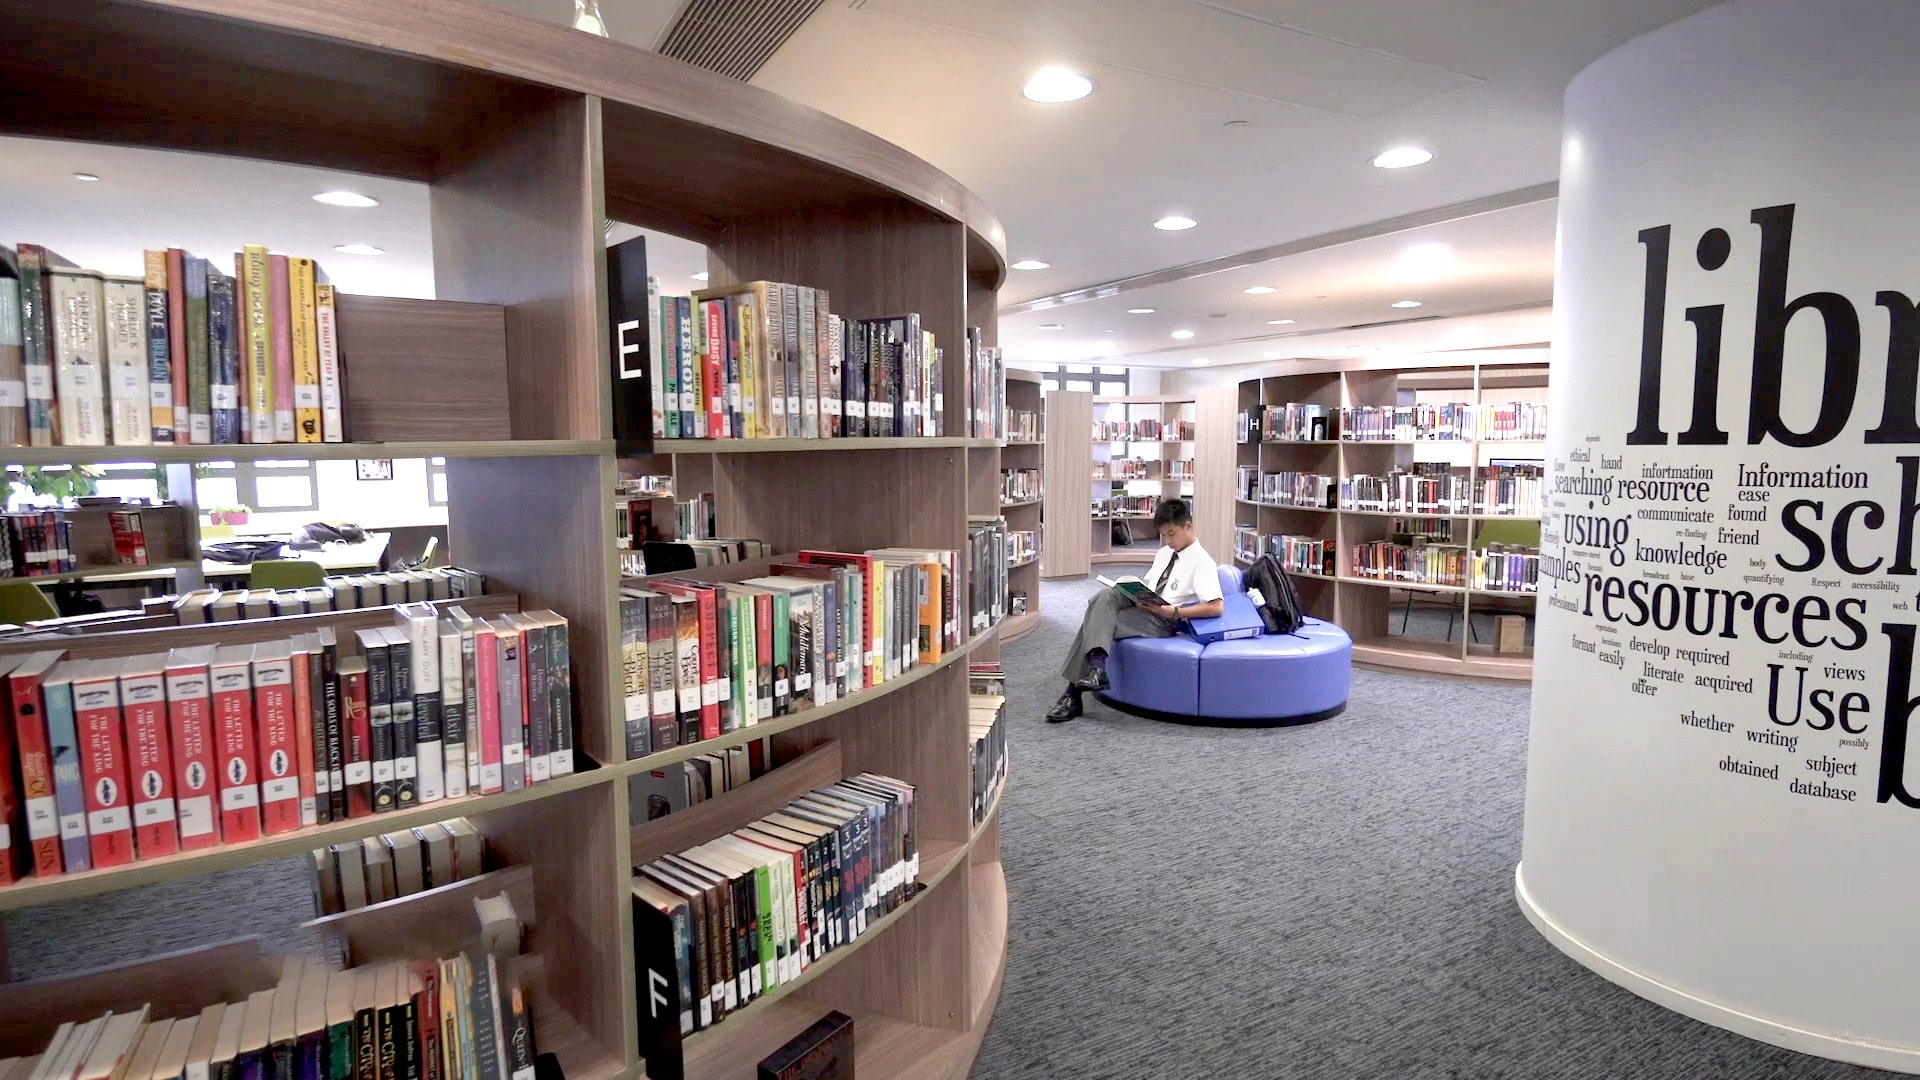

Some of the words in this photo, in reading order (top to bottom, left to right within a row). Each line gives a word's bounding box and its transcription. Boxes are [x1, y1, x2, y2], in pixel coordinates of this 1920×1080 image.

[116, 303, 128, 343] HOLMES
[127, 298, 139, 349] SHERLOCK
[618, 320, 642, 379] E
[681, 317, 692, 393] HEROI
[711, 338, 720, 365] DAISY
[1250, 418, 1259, 431] H
[1570, 448, 1591, 462] ethical
[1601, 454, 1623, 469] hand
[1642, 463, 1714, 480] infortmation
[1738, 462, 1868, 488] Information
[1555, 467, 1614, 505] searching
[1617, 480, 1710, 502] resource
[1738, 490, 1770, 502] ease
[1637, 507, 1715, 523] communicate
[1728, 504, 1767, 521] found
[1564, 501, 1632, 567] using
[1717, 527, 1759, 545] friend
[1635, 539, 1728, 575] knowledge
[1750, 558, 1766, 569] body
[1743, 574, 1784, 586] quantifying
[1811, 578, 1841, 589] Respect
[1851, 581, 1901, 592] accessibility
[1582, 572, 1868, 650] resources
[1892, 601, 1908, 610] web
[421, 626, 429, 657] HILARY
[705, 603, 716, 667] SUSPECT
[1572, 633, 1596, 653] format
[799, 618, 810, 675] Middlemarc
[1629, 637, 1670, 661] develop
[1675, 645, 1730, 667] required
[1778, 650, 1813, 664] including
[664, 651, 674, 689] Burie
[1599, 650, 1625, 670] easily
[423, 661, 431, 683] DUFF
[623, 661, 635, 697] Blad
[1643, 662, 1684, 684] literate
[1694, 672, 1753, 694] acquired
[1823, 663, 1865, 681] views
[325, 682, 333, 694] THE
[1631, 679, 1658, 697] offer
[1767, 663, 1870, 734] Use
[136, 709, 145, 725] FOR
[182, 701, 190, 717] FOR
[327, 695, 335, 721] SOULS
[417, 696, 438, 740] devoted
[89, 714, 99, 730] FOR
[276, 710, 285, 743] LETTER
[329, 727, 337, 735] OF
[446, 708, 461, 740] elixir
[1680, 711, 1735, 734] whether
[193, 721, 202, 754] LETTER
[227, 734, 235, 754] KING
[235, 717, 243, 750] LETTER
[269, 726, 277, 746] KING
[1746, 729, 1799, 753] writing
[1838, 737, 1869, 750] possibly
[102, 735, 113, 769] LETTER
[139, 746, 149, 767] KING
[147, 730, 158, 763] LETTER
[184, 738, 193, 758] KING
[330, 738, 338, 764] BLACK
[93, 752, 103, 774] KING
[1718, 756, 1779, 781] obtained
[1805, 756, 1858, 778] subject
[1789, 778, 1857, 802] database
[845, 831, 850, 842] 3
[855, 824, 860, 834] 3
[39, 842, 55, 870] SUN
[648, 968, 668, 1018] F
[513, 1027, 526, 1061] QUEEN
